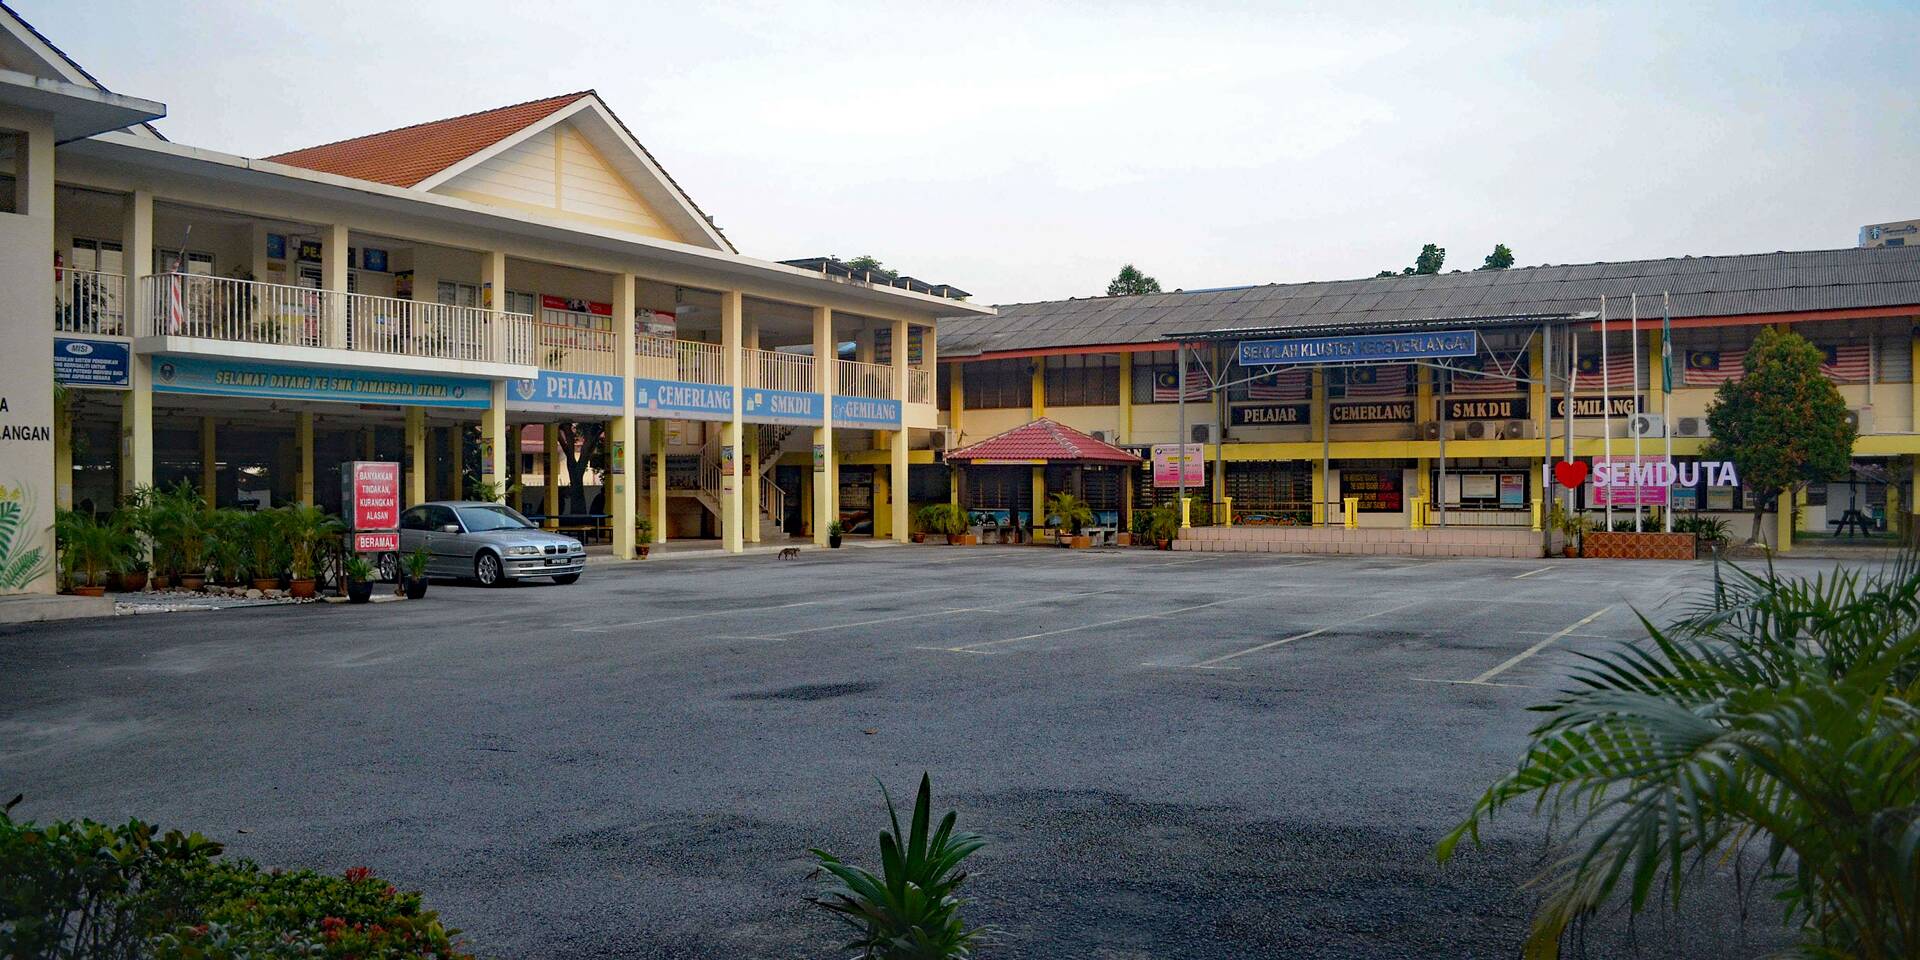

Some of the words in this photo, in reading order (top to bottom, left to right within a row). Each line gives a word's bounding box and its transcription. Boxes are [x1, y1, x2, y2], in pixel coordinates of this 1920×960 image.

[71, 344, 88, 353] MISI
[1301, 342, 1356, 357] KLUSTER
[215, 371, 267, 386] SELAMAT
[271, 374, 311, 390] DATANG
[314, 377, 328, 390] KE
[331, 378, 353, 391] SMK
[356, 379, 413, 396] DAMANSARA
[417, 384, 448, 397] UTAMA
[546, 376, 614, 401] PELAJAR
[658, 385, 731, 409] CEMERLANG
[771, 395, 811, 414] SMKDU
[846, 401, 896, 419] GEMILANG
[1244, 407, 1297, 423] PELAJAR
[1333, 404, 1411, 421] CEMERLANG
[1452, 401, 1512, 418] SMKDU
[0, 425, 50, 441] ANGAN
[359, 471, 393, 481] BANYAKKAN
[1543, 463, 1549, 488] I
[1592, 460, 1739, 487] SEMDUTA
[362, 485, 390, 494] TINDAKAN,
[360, 498, 394, 507] KURANGKAN
[366, 511, 389, 520] ALASAN
[360, 537, 394, 548] BERAMAL
